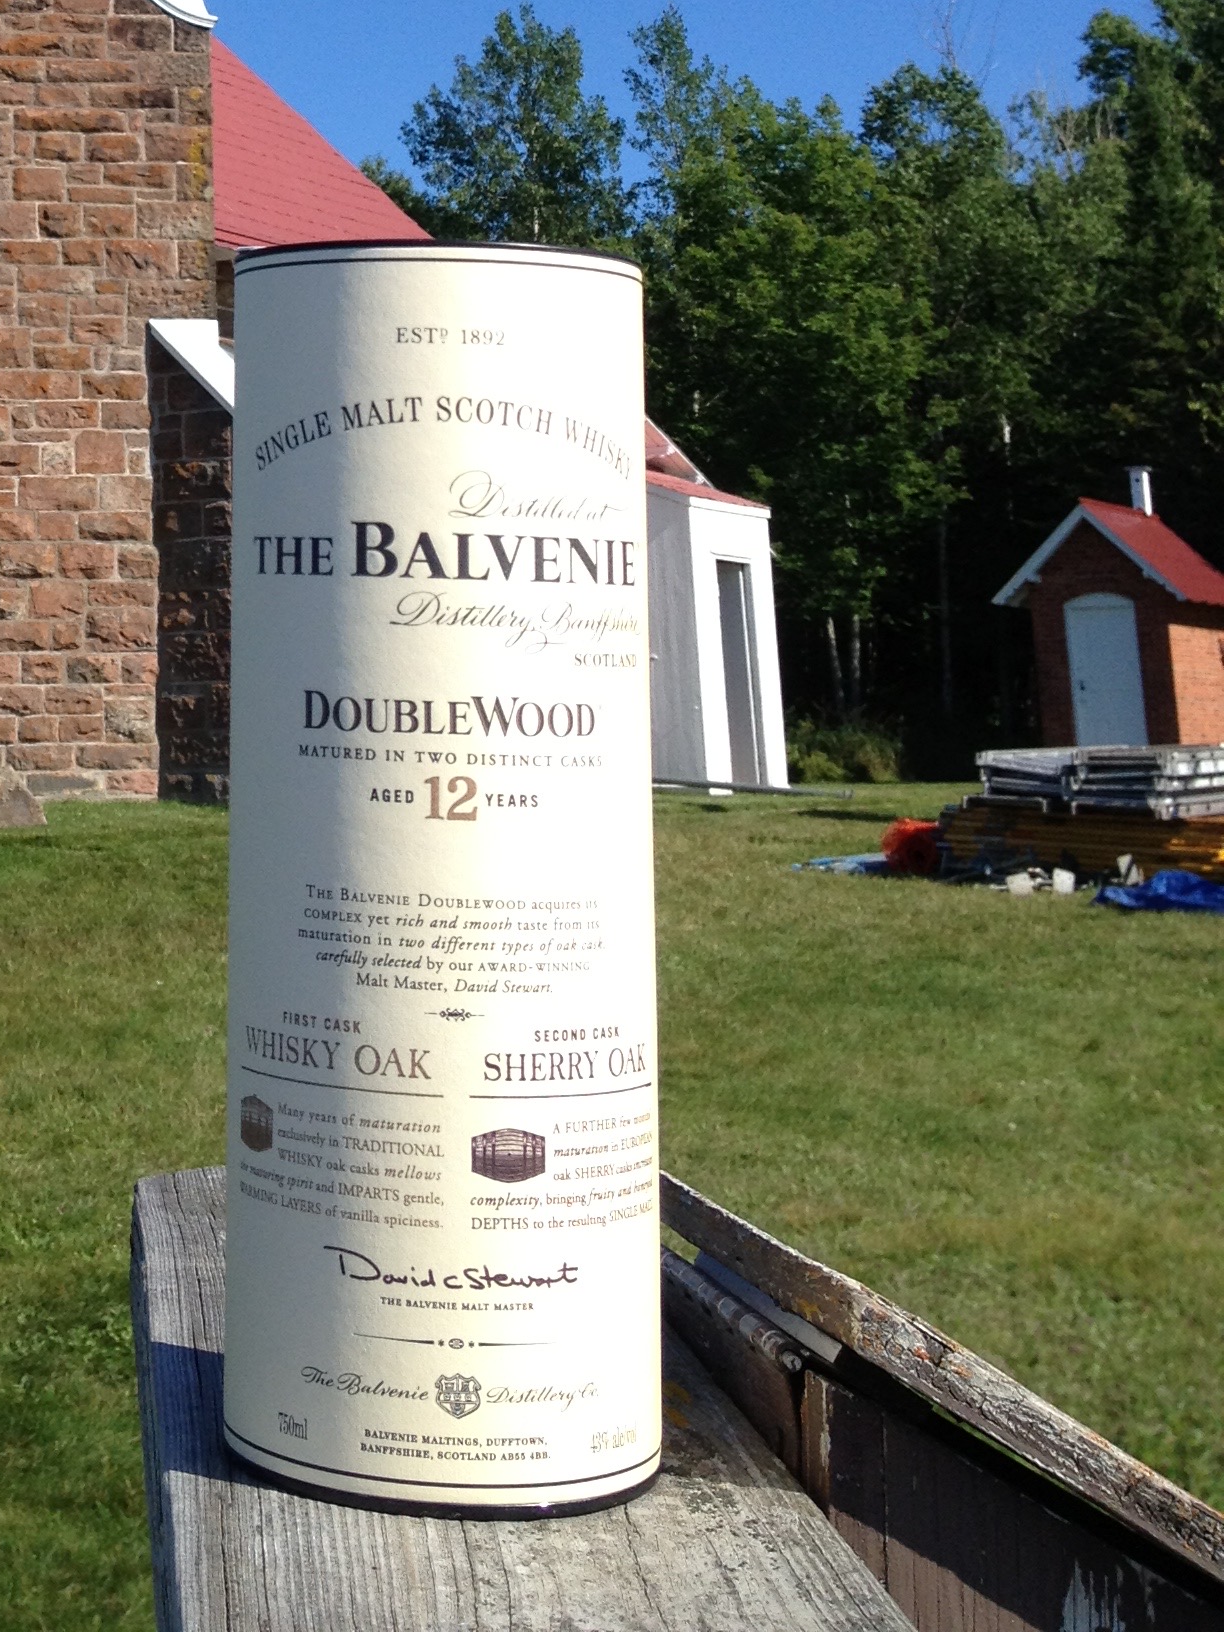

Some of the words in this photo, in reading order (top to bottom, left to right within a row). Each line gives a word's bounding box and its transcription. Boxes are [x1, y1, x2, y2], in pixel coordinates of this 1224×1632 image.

[461, 329, 505, 346] 1892
[255, 411, 332, 471] SINGLE
[341, 396, 423, 431] MALT
[436, 396, 552, 436] SCOTCH
[448, 470, 588, 519] Distilled
[254, 536, 334, 576] THE
[350, 520, 636, 587] BALVENIE
[574, 653, 637, 668] SCOTLAND
[298, 744, 377, 762] MATURED
[385, 749, 405, 763] IN
[414, 750, 458, 765] TWO
[466, 752, 553, 768] DISTINCT
[561, 755, 603, 768] CASKS
[370, 787, 415, 804] AGED
[423, 775, 478, 821] 12
[485, 793, 539, 808] YEARS
[306, 884, 333, 900] THE
[340, 887, 411, 906] BALVENIE
[531, 899, 581, 914] acquires
[304, 908, 362, 923] COMPLEX
[368, 914, 389, 928] yet
[396, 914, 424, 927] rich
[429, 915, 459, 929] and
[463, 917, 513, 931] smooth
[517, 920, 548, 931] taste
[554, 917, 582, 931] from
[298, 928, 371, 945] maturation
[377, 932, 392, 946] in
[398, 937, 425, 948] two
[431, 935, 496, 955] different
[502, 941, 534, 956] types
[539, 938, 555, 956] of
[556, 937, 577, 951] oak
[315, 949, 368, 969] carefully
[371, 953, 423, 969] selected
[426, 956, 444, 974] by
[448, 962, 474, 972] our
[477, 961, 591, 973] AWARD-WINNING
[356, 972, 389, 988] Malt
[393, 975, 448, 993] Master,
[454, 978, 498, 993] David
[502, 979, 553, 994] Stewart.
[283, 1011, 317, 1029] FIRST
[324, 1018, 362, 1035] CASK
[534, 1028, 586, 1043] SECOND
[592, 1026, 620, 1040] CASK
[245, 1025, 341, 1070] WHISKY
[354, 1043, 432, 1080] OAK
[483, 1050, 599, 1082] SHERRY
[608, 1042, 646, 1078] OAK
[277, 1102, 305, 1120] Many
[309, 1111, 336, 1125] years
[342, 1113, 356, 1126] of
[359, 1117, 441, 1134] maturation
[552, 1123, 561, 1135] A
[565, 1117, 617, 1134] FURTHER
[277, 1127, 327, 1149] exclusively
[328, 1135, 340, 1148] in
[342, 1136, 445, 1158] TRADITIONAL
[553, 1143, 609, 1158] maturation
[277, 1148, 323, 1169] WHISKY
[326, 1158, 345, 1172] oak
[349, 1163, 380, 1177] casks
[384, 1165, 442, 1181] mellows
[553, 1168, 571, 1182] oak
[574, 1164, 616, 1180] SHERRY
[287, 1175, 313, 1194] spirit
[316, 1181, 335, 1195] and
[338, 1182, 400, 1202] IMPARTS
[403, 1192, 445, 1207] gentle,
[470, 1192, 543, 1211] complexity,
[546, 1192, 587, 1208] bringing
[587, 1187, 615, 1207] fruity
[280, 1195, 322, 1215] LAYERS
[325, 1205, 338, 1218] of
[340, 1209, 380, 1224] vanilla
[383, 1214, 445, 1229] spiciness.
[471, 1217, 529, 1230] DEPTHS
[533, 1219, 544, 1229] to
[548, 1217, 565, 1229] the
[567, 1214, 607, 1228] resulting
[323, 1245, 436, 1287] David
[463, 1261, 579, 1290] Stewart
[379, 1296, 402, 1307] THE
[405, 1299, 457, 1311] BALVENIE
[461, 1302, 490, 1311] MALT
[494, 1302, 534, 1311] MASTER
[301, 1366, 334, 1387] The
[337, 1372, 429, 1401] Balvenie
[486, 1386, 576, 1412] Distillery
[278, 1412, 308, 1440] 750ml
[364, 1429, 418, 1444] BALVENIE
[421, 1435, 482, 1448] MALTINGS,
[360, 1442, 434, 1461] BANFFSHIRE,
[437, 1451, 496, 1462] SCOTLAND
[500, 1452, 526, 1461] AB55
